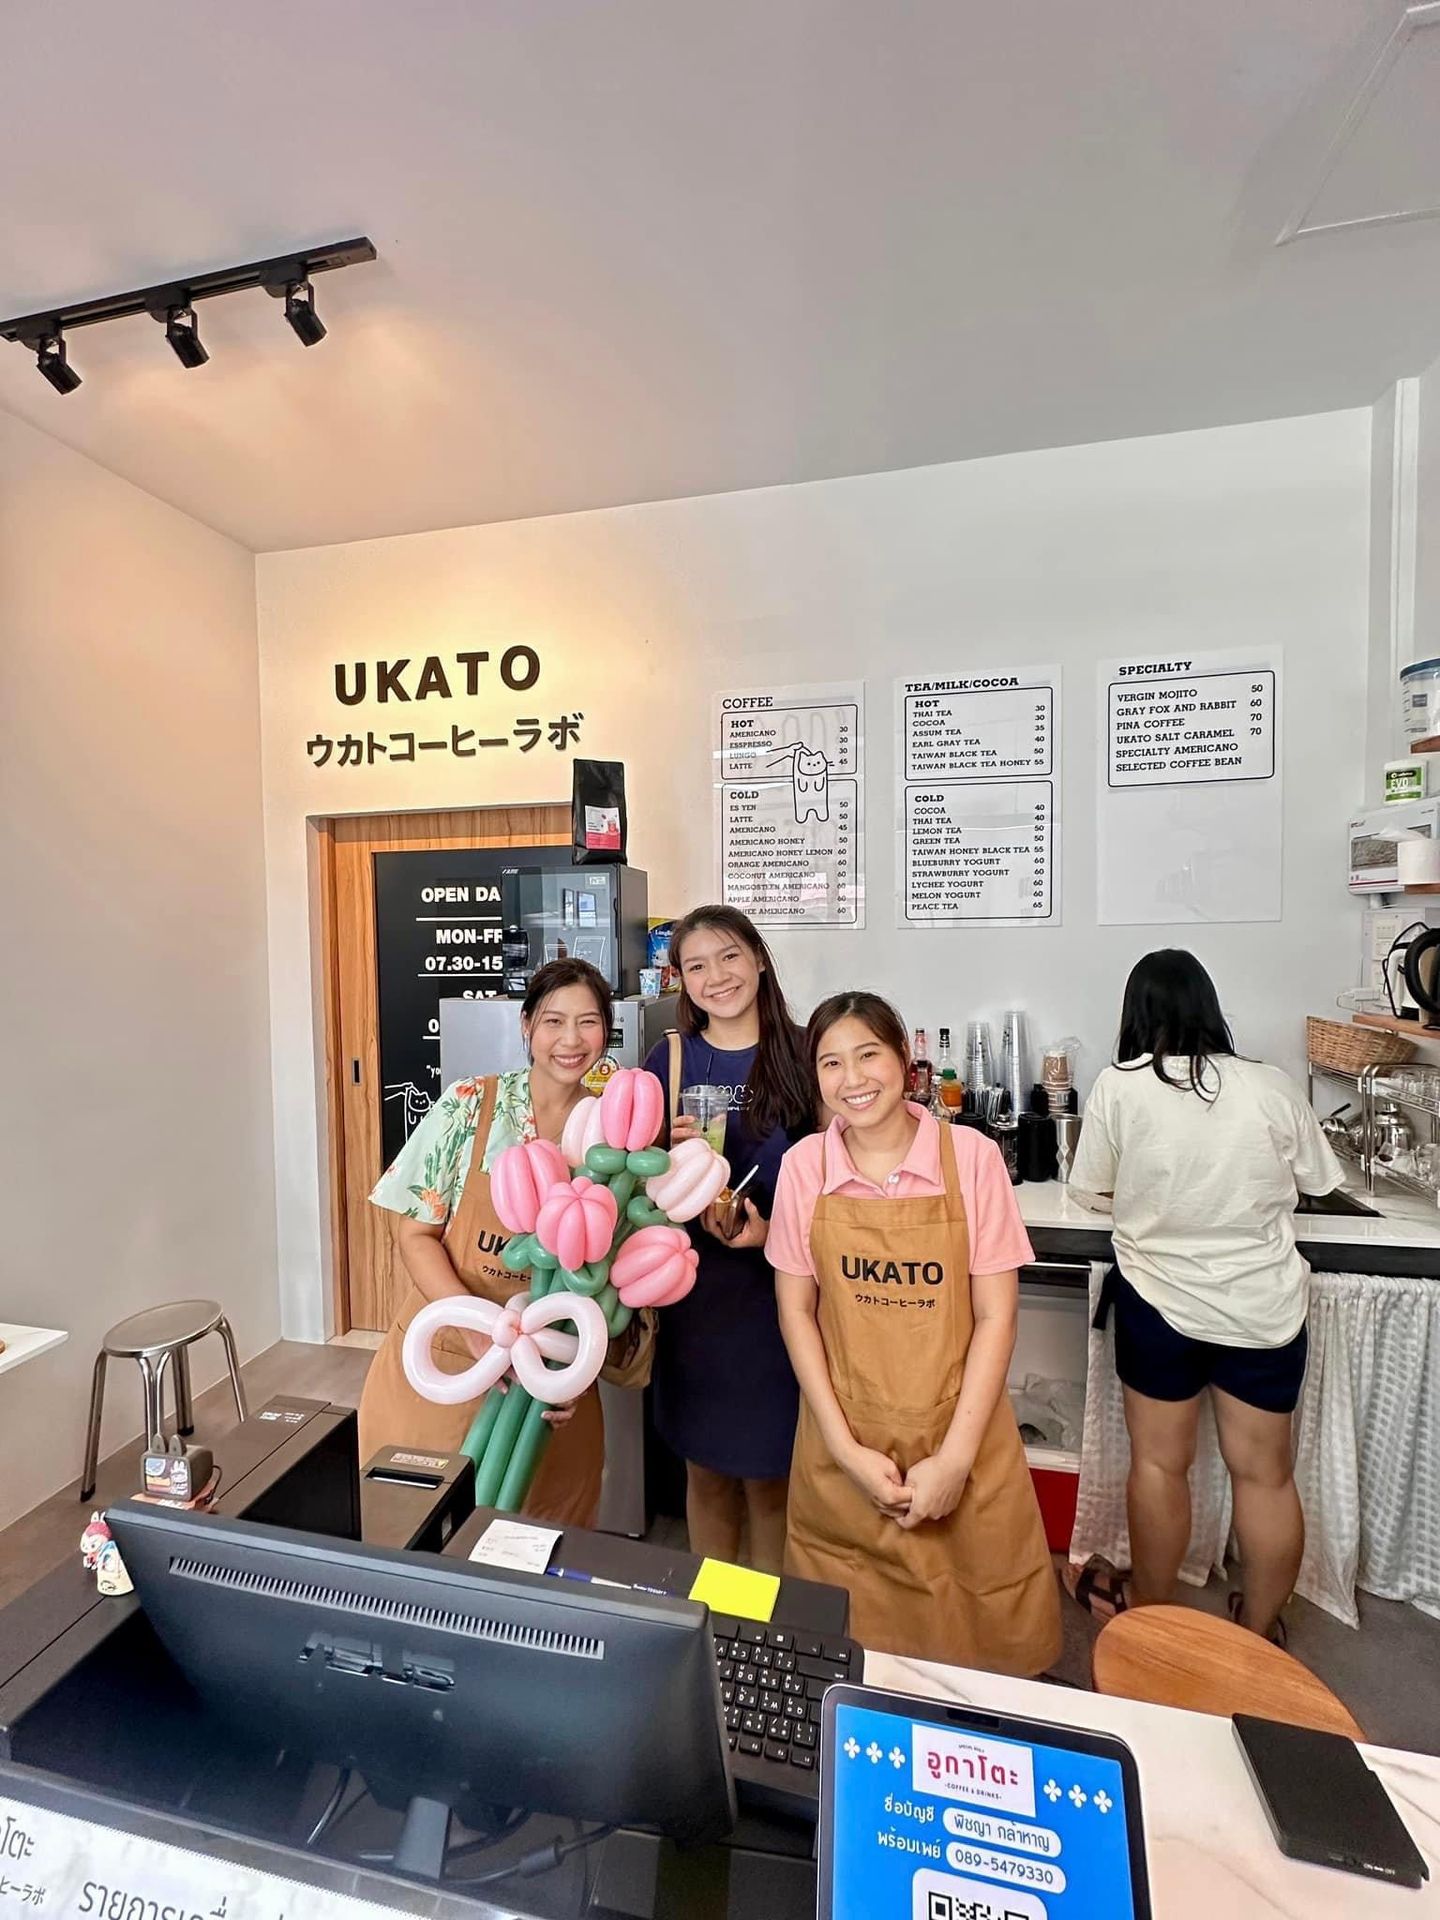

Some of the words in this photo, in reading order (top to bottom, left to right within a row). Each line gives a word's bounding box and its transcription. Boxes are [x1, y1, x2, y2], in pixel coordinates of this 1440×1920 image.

[335, 645, 540, 706] UKATO
[1119, 661, 1192, 675] SPECIALTY
[905, 677, 1019, 692] TEA/MILK/COCOA
[723, 697, 773, 709] COFFEE
[1118, 692, 1155, 702] VERGIN
[1159, 689, 1198, 699] MOJITO
[915, 700, 940, 708] HOT
[1117, 707, 1146, 716] GRAY
[1150, 705, 1170, 714] FOX
[1174, 704, 1196, 712] AND
[1200, 700, 1237, 710] RABBIT
[1250, 699, 1262, 707] 60
[731, 720, 754, 728] HOT
[1117, 721, 1140, 730] PINA
[1144, 718, 1185, 728] COFFEE
[1251, 713, 1262, 721] 70
[306, 712, 585, 767] ウカトコーヒーラボ
[730, 730, 776, 738] AMERICANO
[1117, 735, 1151, 744] UKATO
[1155, 732, 1181, 742] SALT
[1184, 729, 1235, 740] CARAMEL
[1116, 747, 1170, 758] SPECIALTY
[1174, 743, 1238, 754] AMERICANO
[1000, 759, 1031, 767] HONEY
[1116, 762, 1166, 772] SELECTED
[1170, 759, 1211, 769] COFFEE
[1215, 757, 1242, 766] BEAN
[730, 791, 759, 799] COLD
[730, 826, 775, 834] AMERICANO
[964, 858, 1001, 866] YOGURT
[421, 887, 469, 903] OPEN
[842, 1255, 943, 1285] UKATO
[855, 1294, 935, 1308] ウカトコーヒーラボ
[928, 1751, 1018, 1786] อูกาโตะ
[877, 1826, 941, 1858] พร้อมเพย์
[997, 1820, 1050, 1852] กล้าหาญ
[955, 1849, 1053, 1884] 089-5479330
